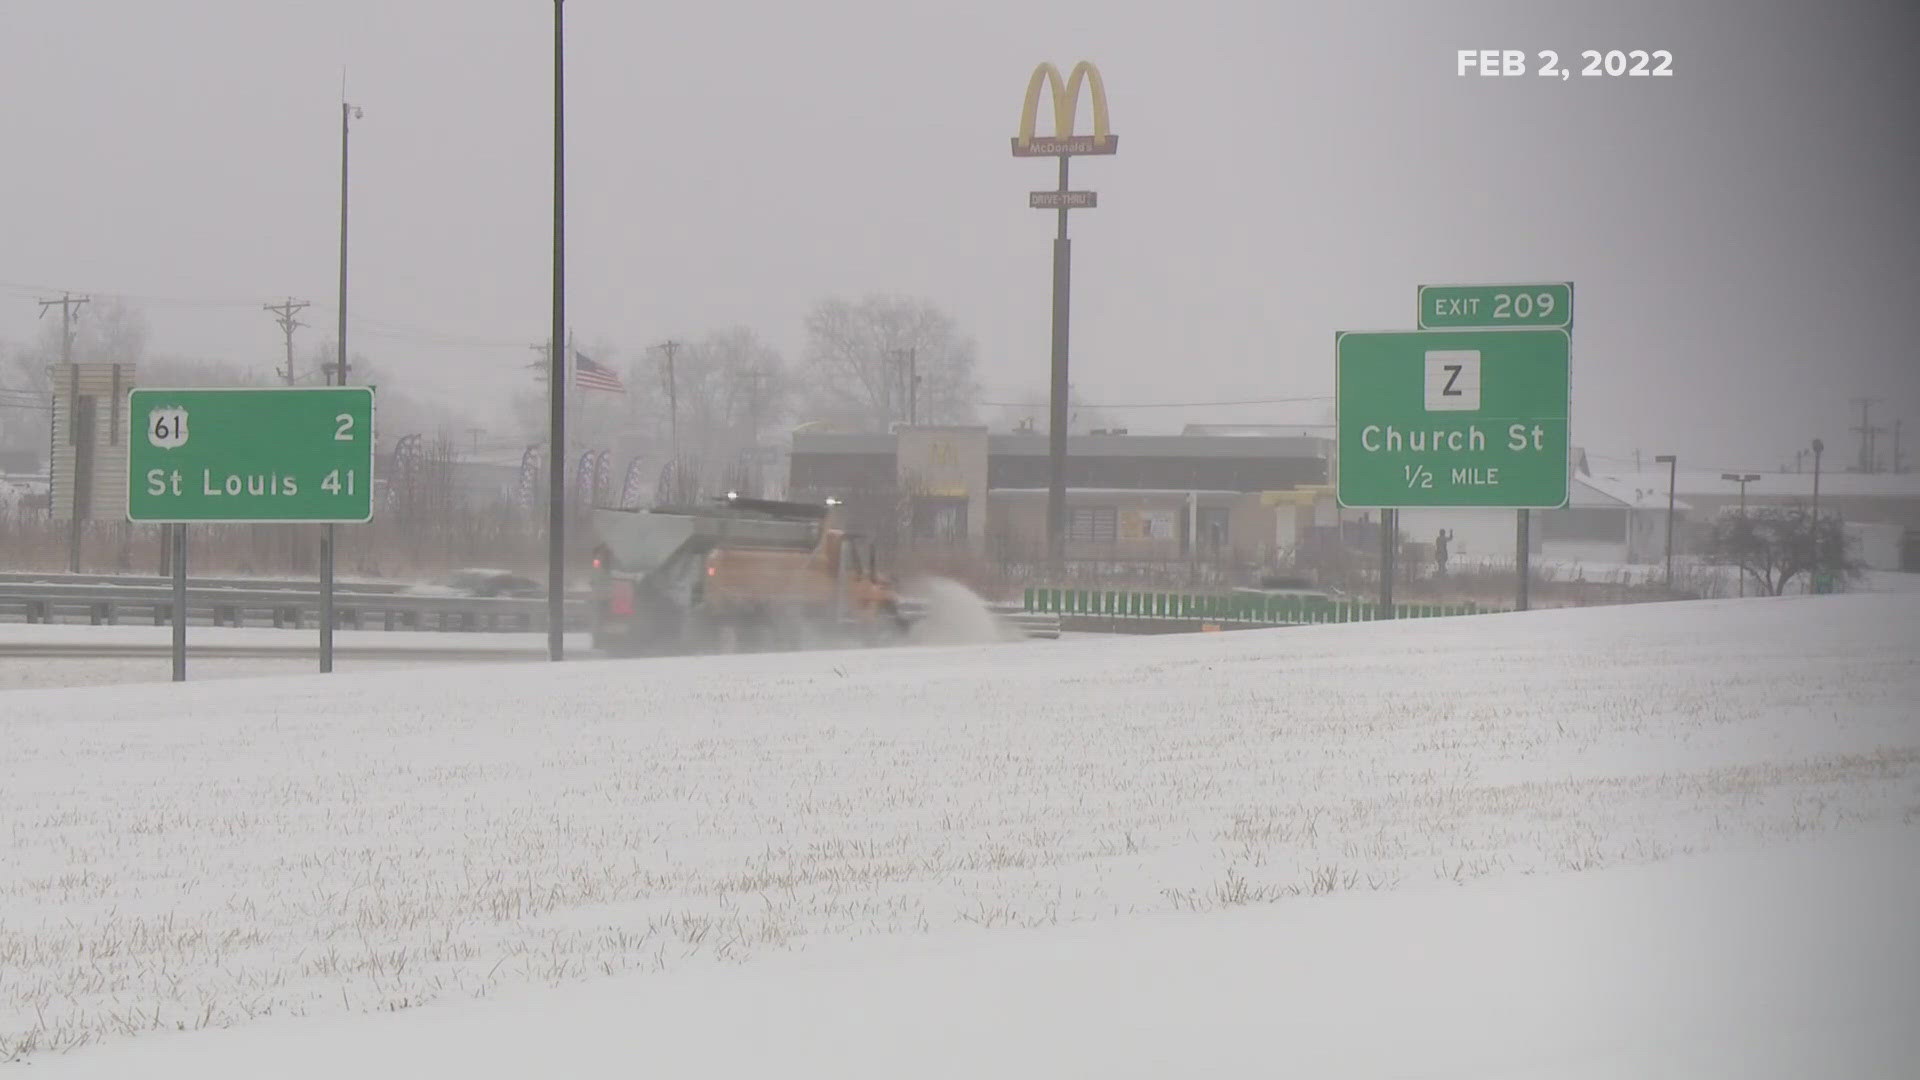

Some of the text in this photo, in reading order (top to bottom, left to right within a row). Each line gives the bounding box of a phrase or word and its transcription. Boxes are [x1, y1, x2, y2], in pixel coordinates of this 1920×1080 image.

[1435, 293, 1555, 318] EXIT 209
[1442, 364, 1463, 396] Z
[155, 413, 355, 441] 61 2
[1361, 424, 1544, 452] Church St
[147, 468, 355, 497] St Louis 41
[1452, 468, 1499, 485] MILE
